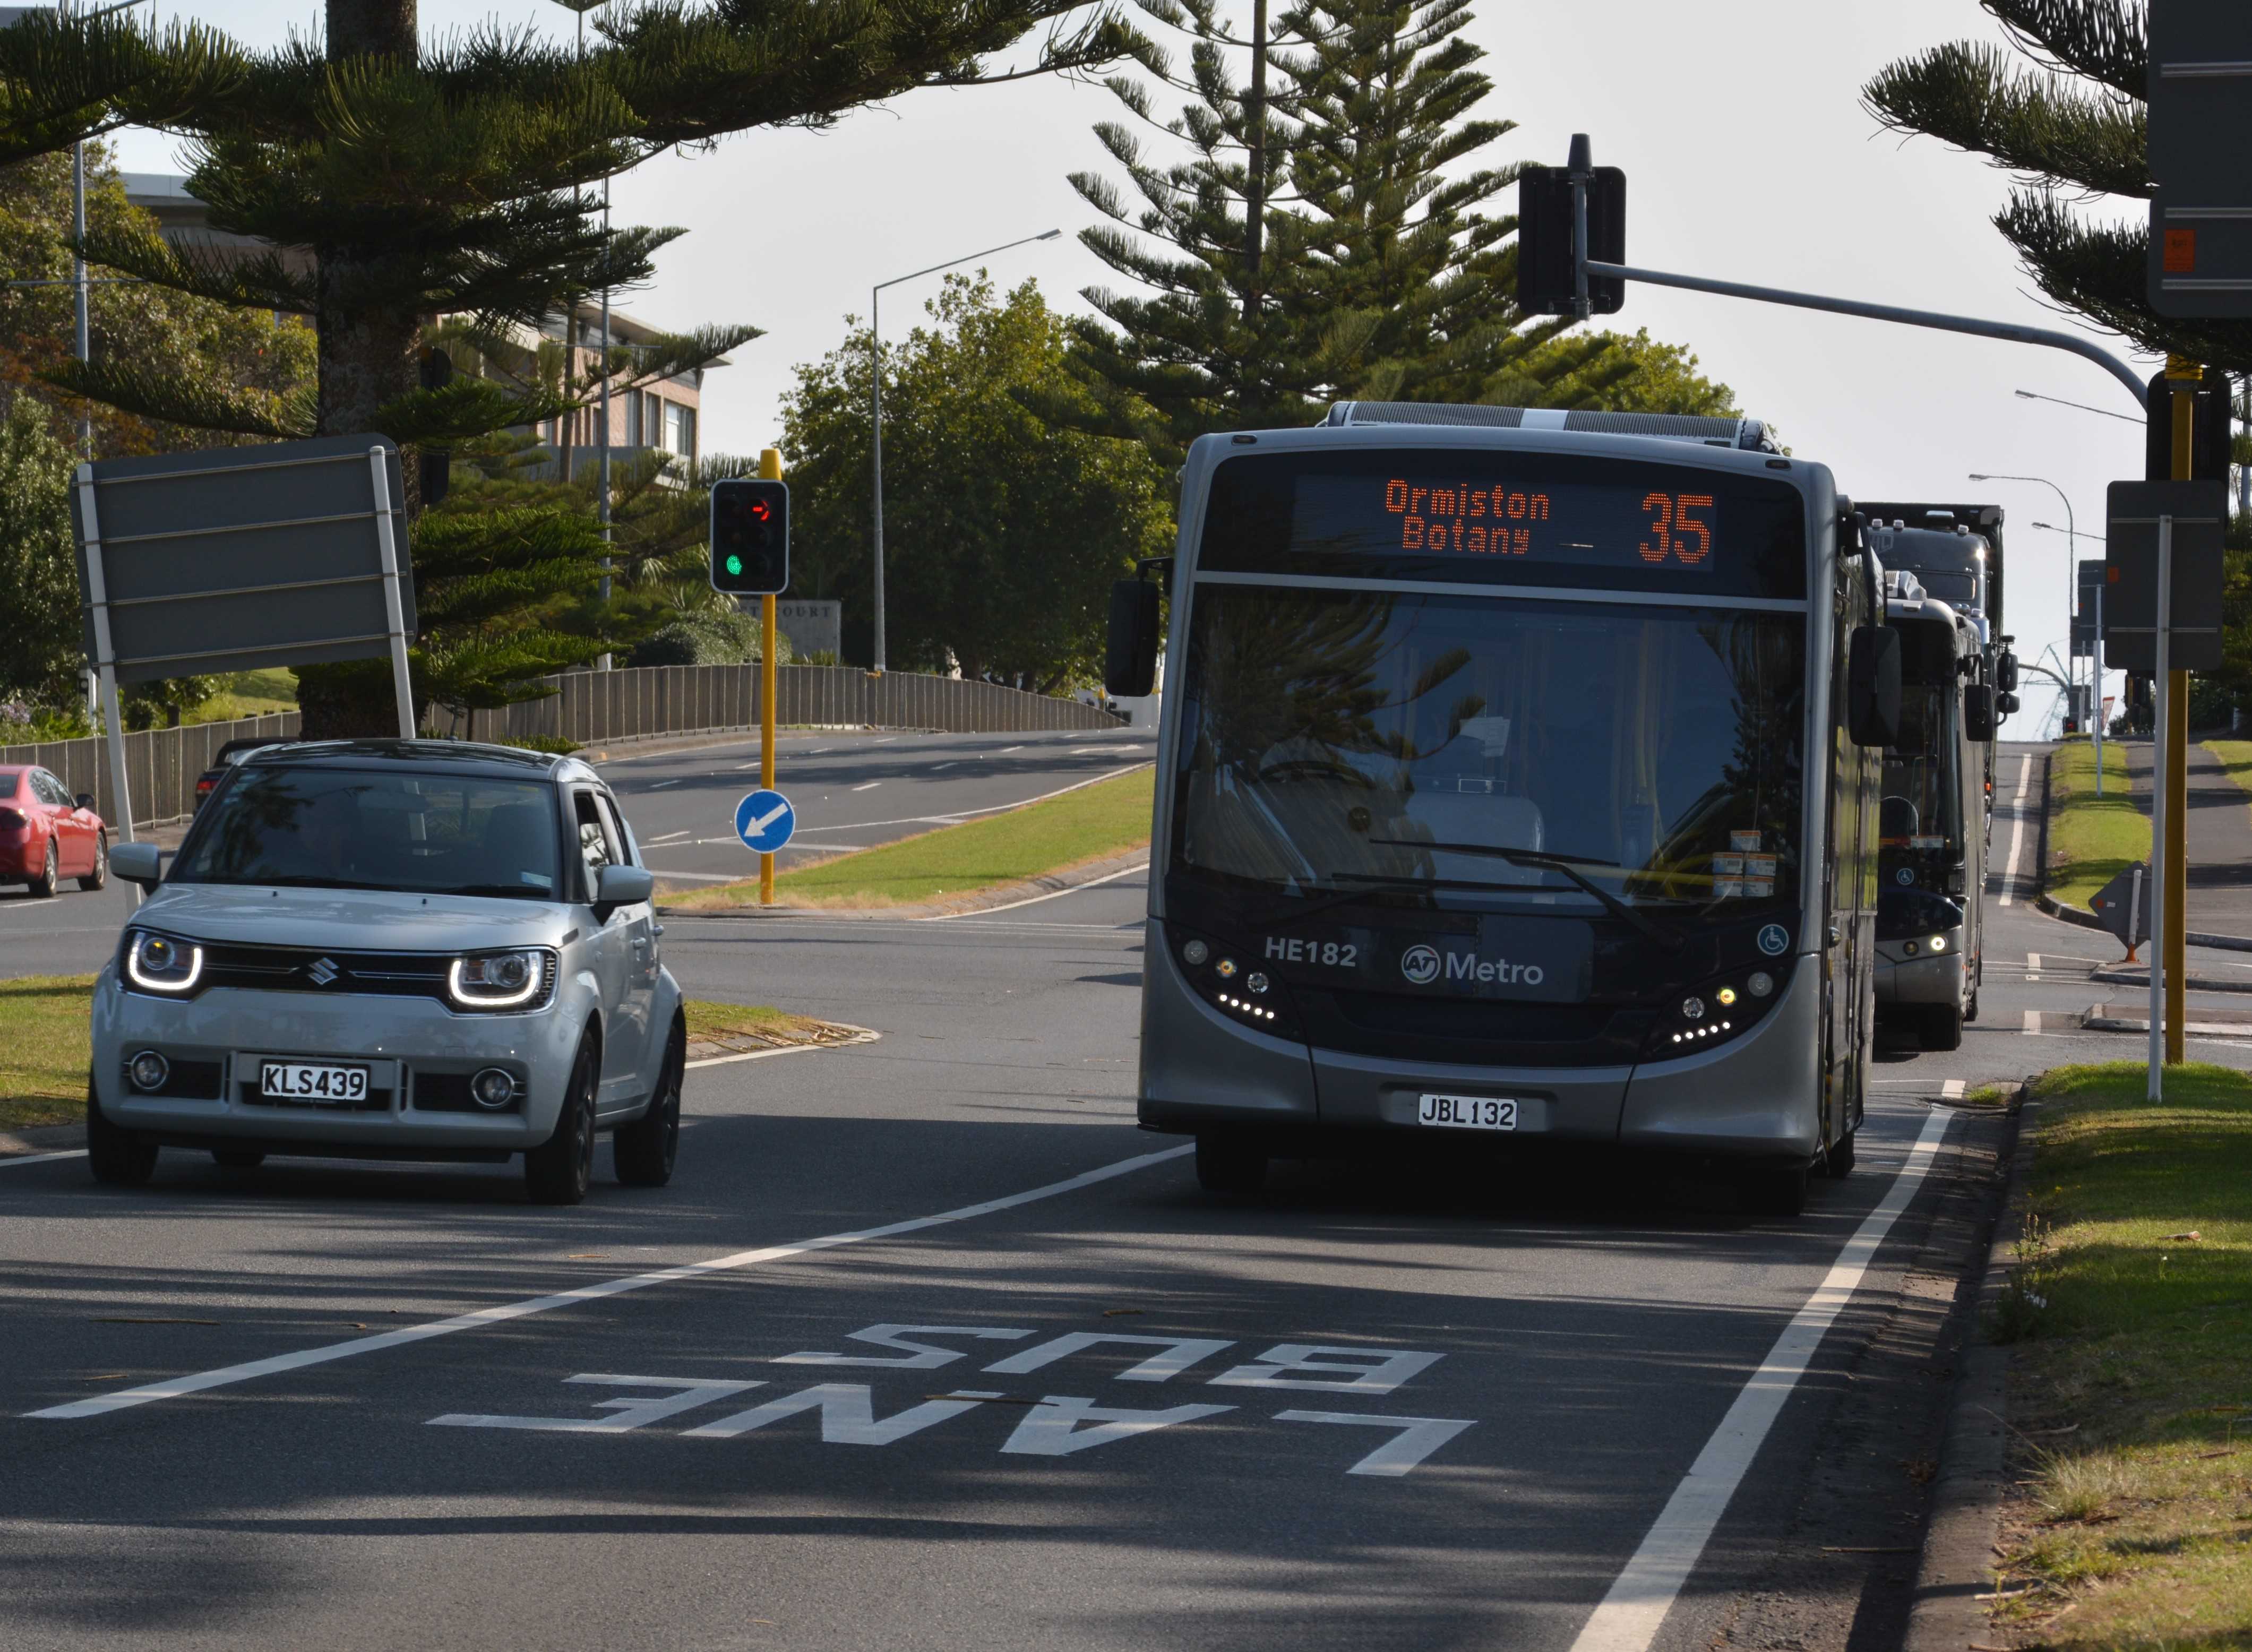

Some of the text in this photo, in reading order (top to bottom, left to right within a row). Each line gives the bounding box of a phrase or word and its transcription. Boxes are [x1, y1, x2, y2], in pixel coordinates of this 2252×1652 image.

[1386, 479, 1549, 520] Ormiston
[1403, 515, 1529, 555] Botany
[1639, 492, 1713, 563] 35
[776, 606, 831, 617] OURT
[1265, 936, 1357, 968] HE182
[1445, 952, 1544, 985] Metro
[263, 1067, 365, 1097] KLS439
[1422, 1098, 1515, 1126] JBL132
[769, 1323, 1448, 1395] BUS
[421, 1373, 1479, 1476] LANE
